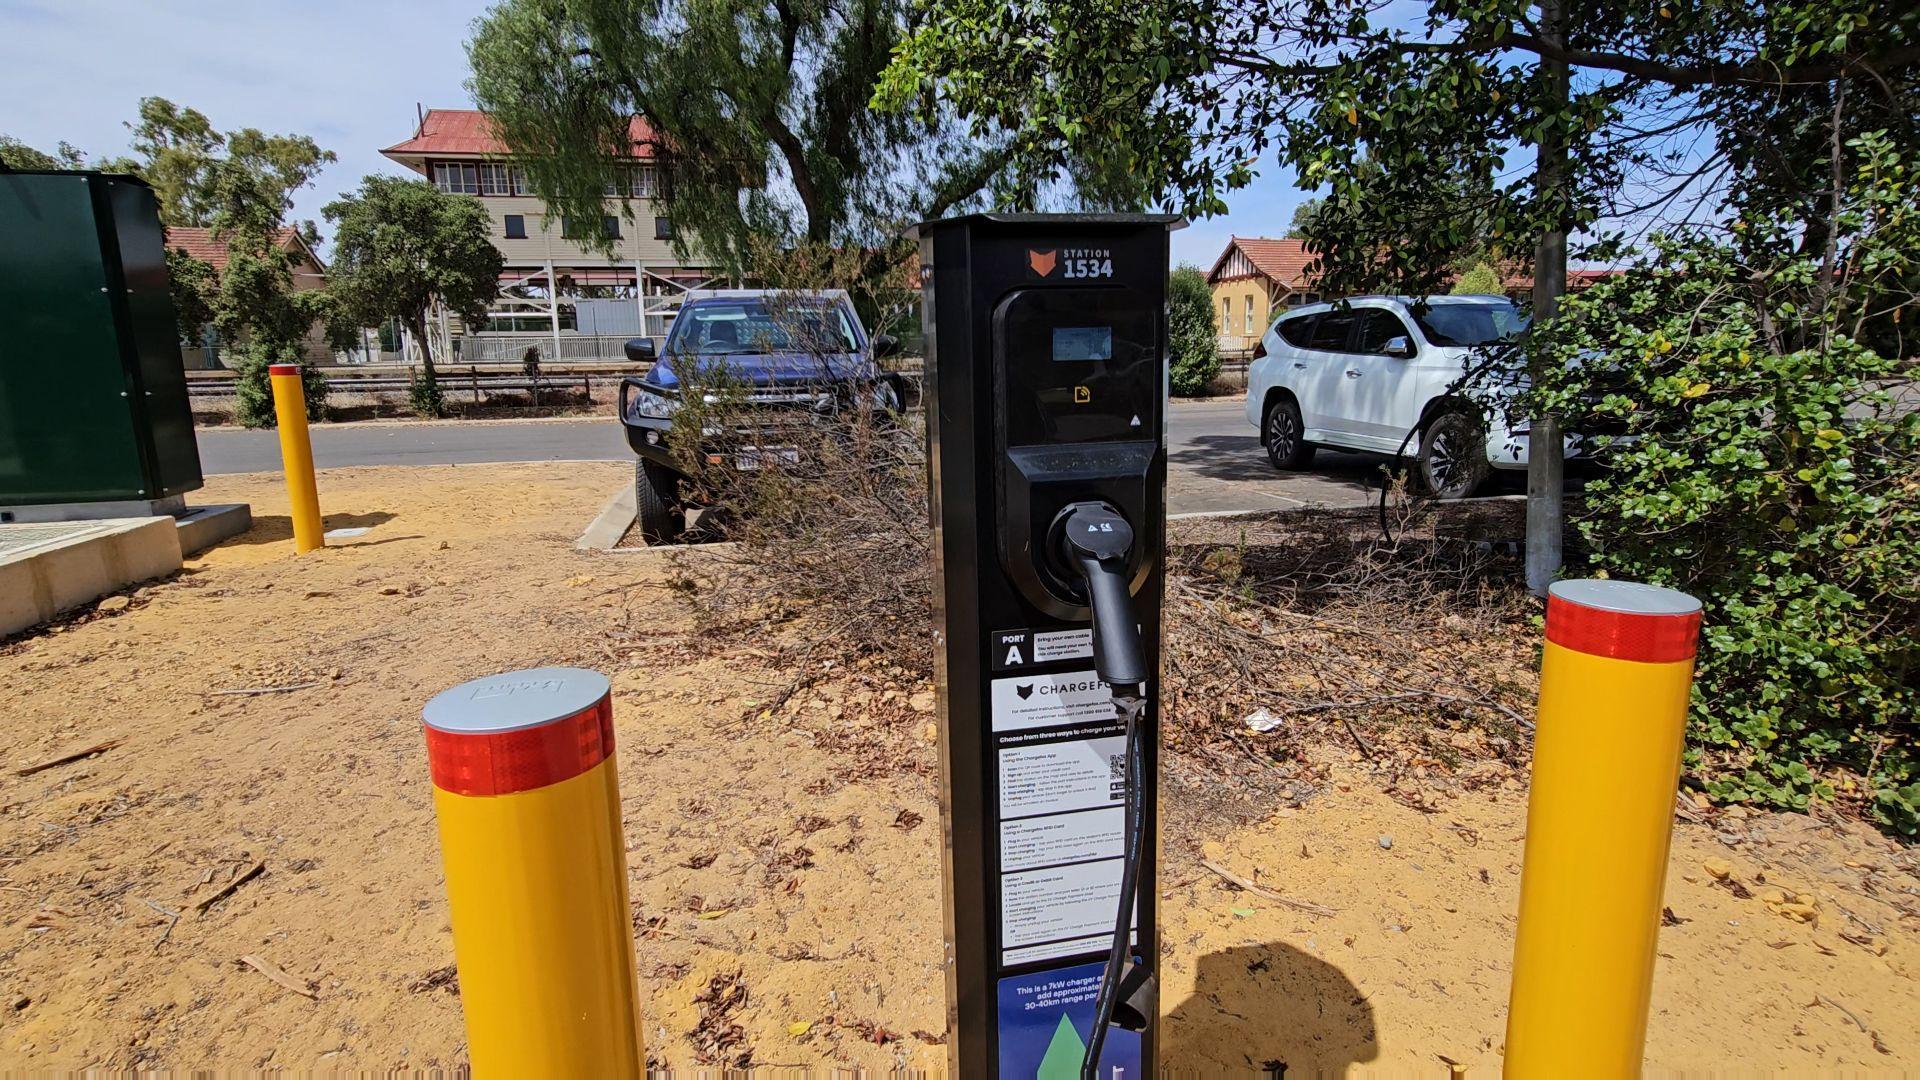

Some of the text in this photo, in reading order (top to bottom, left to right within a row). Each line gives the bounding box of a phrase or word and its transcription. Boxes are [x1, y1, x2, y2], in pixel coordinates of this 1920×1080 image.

[1063, 249, 1110, 258] STATION
[1064, 259, 1113, 278] 1534
[1002, 634, 1025, 643] PORT
[1005, 645, 1024, 666] A
[1040, 681, 1112, 695] CHARGEFO
[1000, 735, 1024, 743] Choose
[1024, 732, 1039, 741] from
[1039, 731, 1056, 739] three
[1056, 730, 1073, 738] ways
[1081, 726, 1102, 736] charge
[1016, 986, 1033, 995] This
[1034, 984, 1041, 993] is
[1042, 983, 1047, 991] a
[1048, 981, 1065, 990] 7kW
[1067, 979, 1095, 988] charger
[1037, 985, 1101, 1000] add approximatel
[1025, 993, 1097, 1009] 30-40km range per
